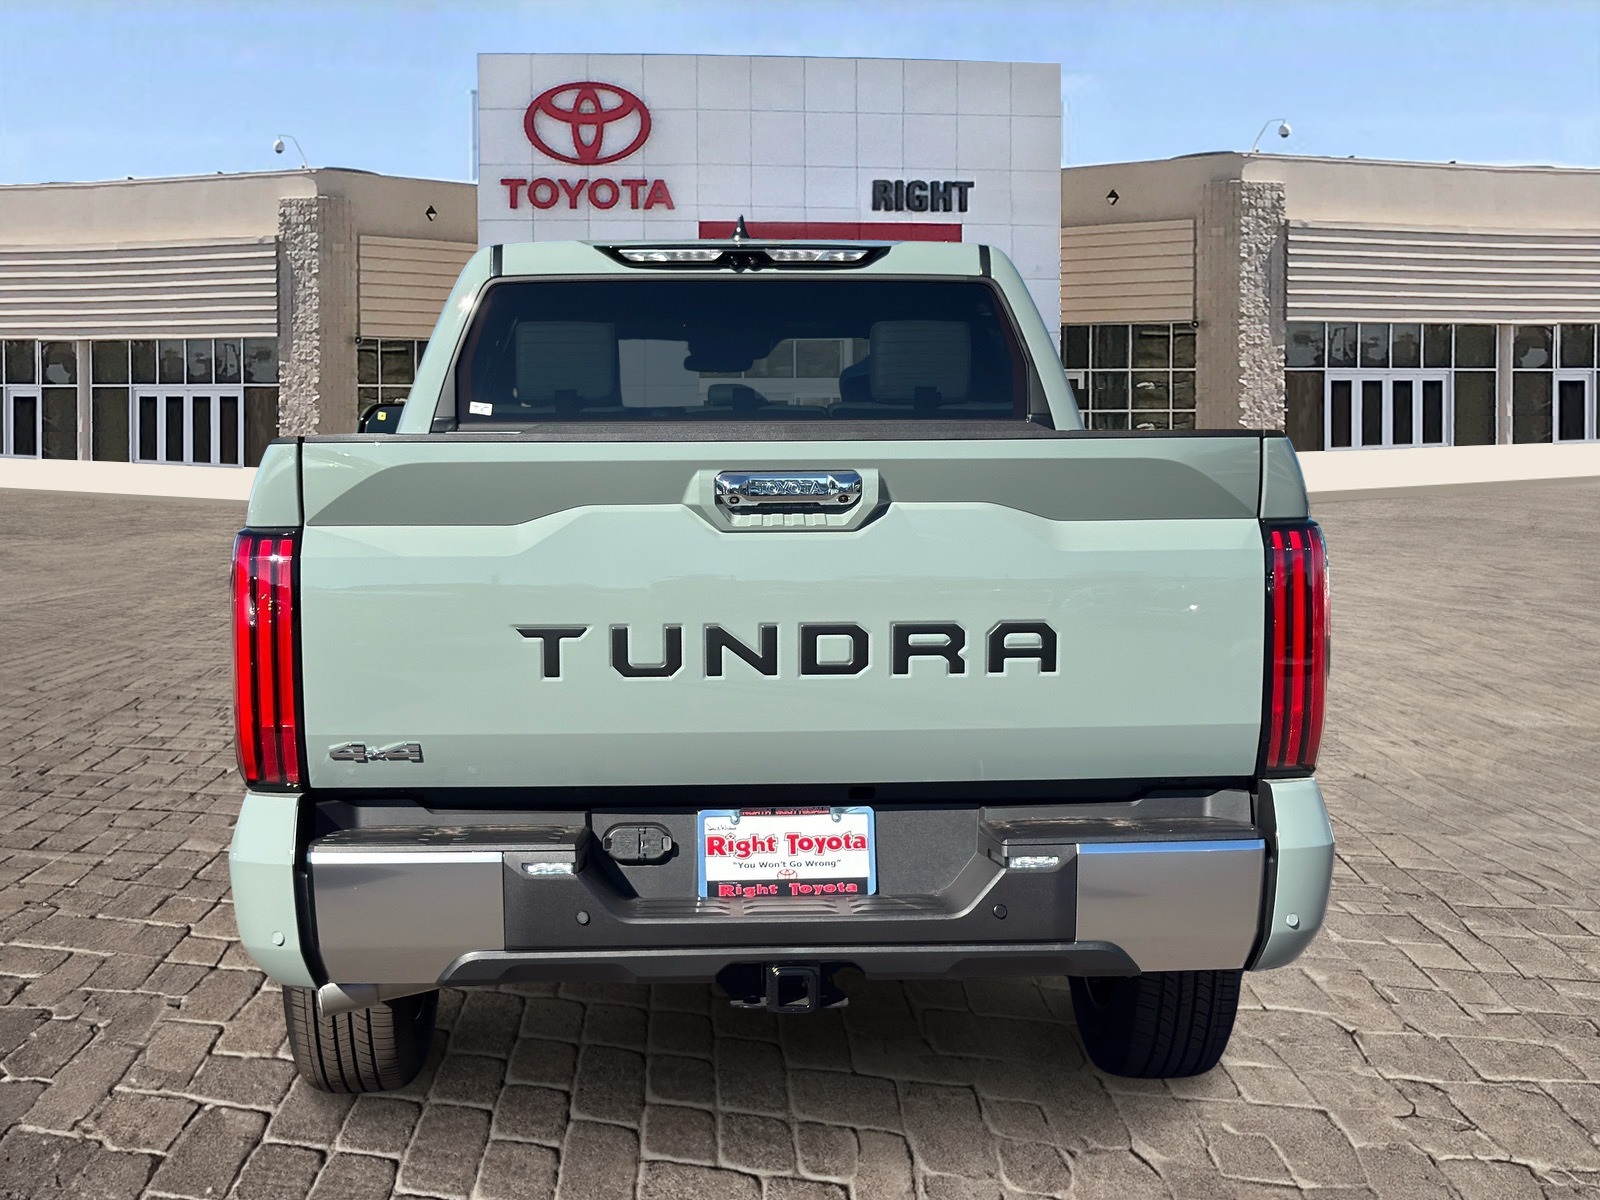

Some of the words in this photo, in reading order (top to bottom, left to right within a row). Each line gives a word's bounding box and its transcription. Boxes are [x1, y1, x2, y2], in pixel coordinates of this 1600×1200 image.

[500, 178, 675, 210] TOYOTA
[871, 179, 975, 213] RIGHT
[756, 479, 822, 496] TOYOTA
[510, 621, 1061, 681] TUNDRA
[706, 832, 778, 859] Right
[785, 831, 869, 857] Toyota
[789, 860, 803, 868] Go
[718, 884, 778, 897] Right
[789, 882, 858, 896] Toyota
